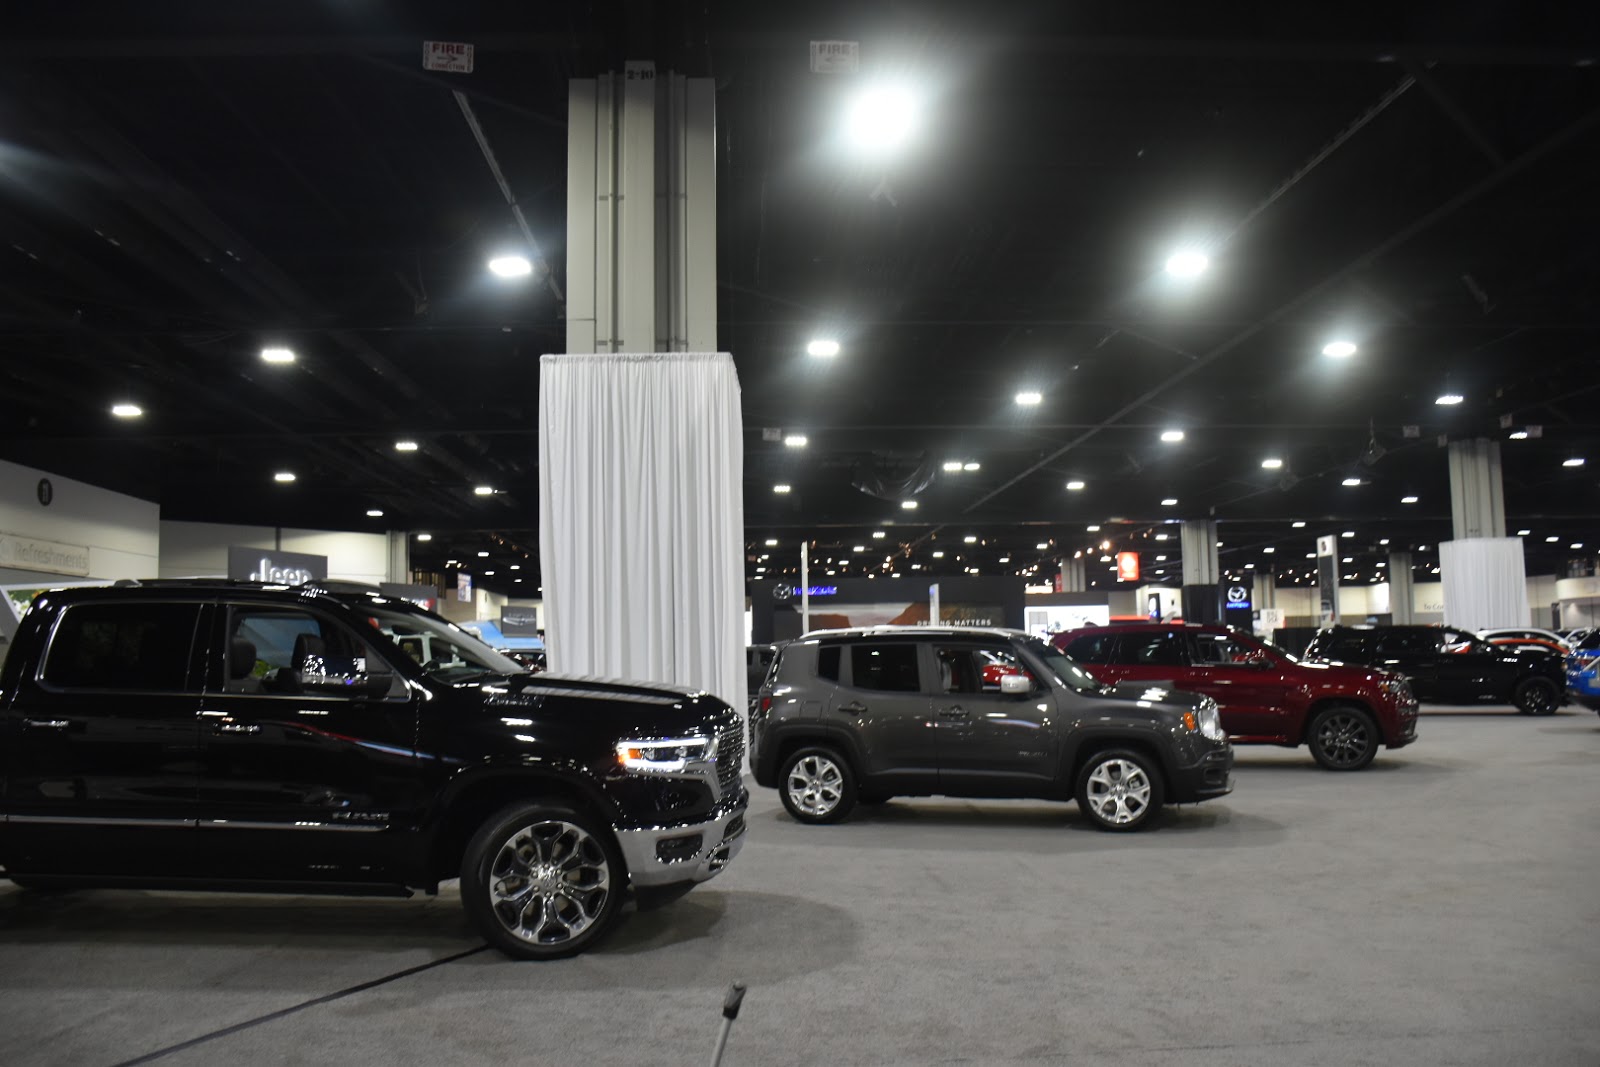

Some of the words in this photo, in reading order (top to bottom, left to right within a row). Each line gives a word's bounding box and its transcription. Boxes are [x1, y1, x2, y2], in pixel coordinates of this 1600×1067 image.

[432, 42, 465, 55] FIRE
[819, 43, 850, 55] FIRE
[15, 542, 88, 569] Refreshments
[250, 559, 312, 586] Jeep
[954, 619, 992, 627] MATTERS
